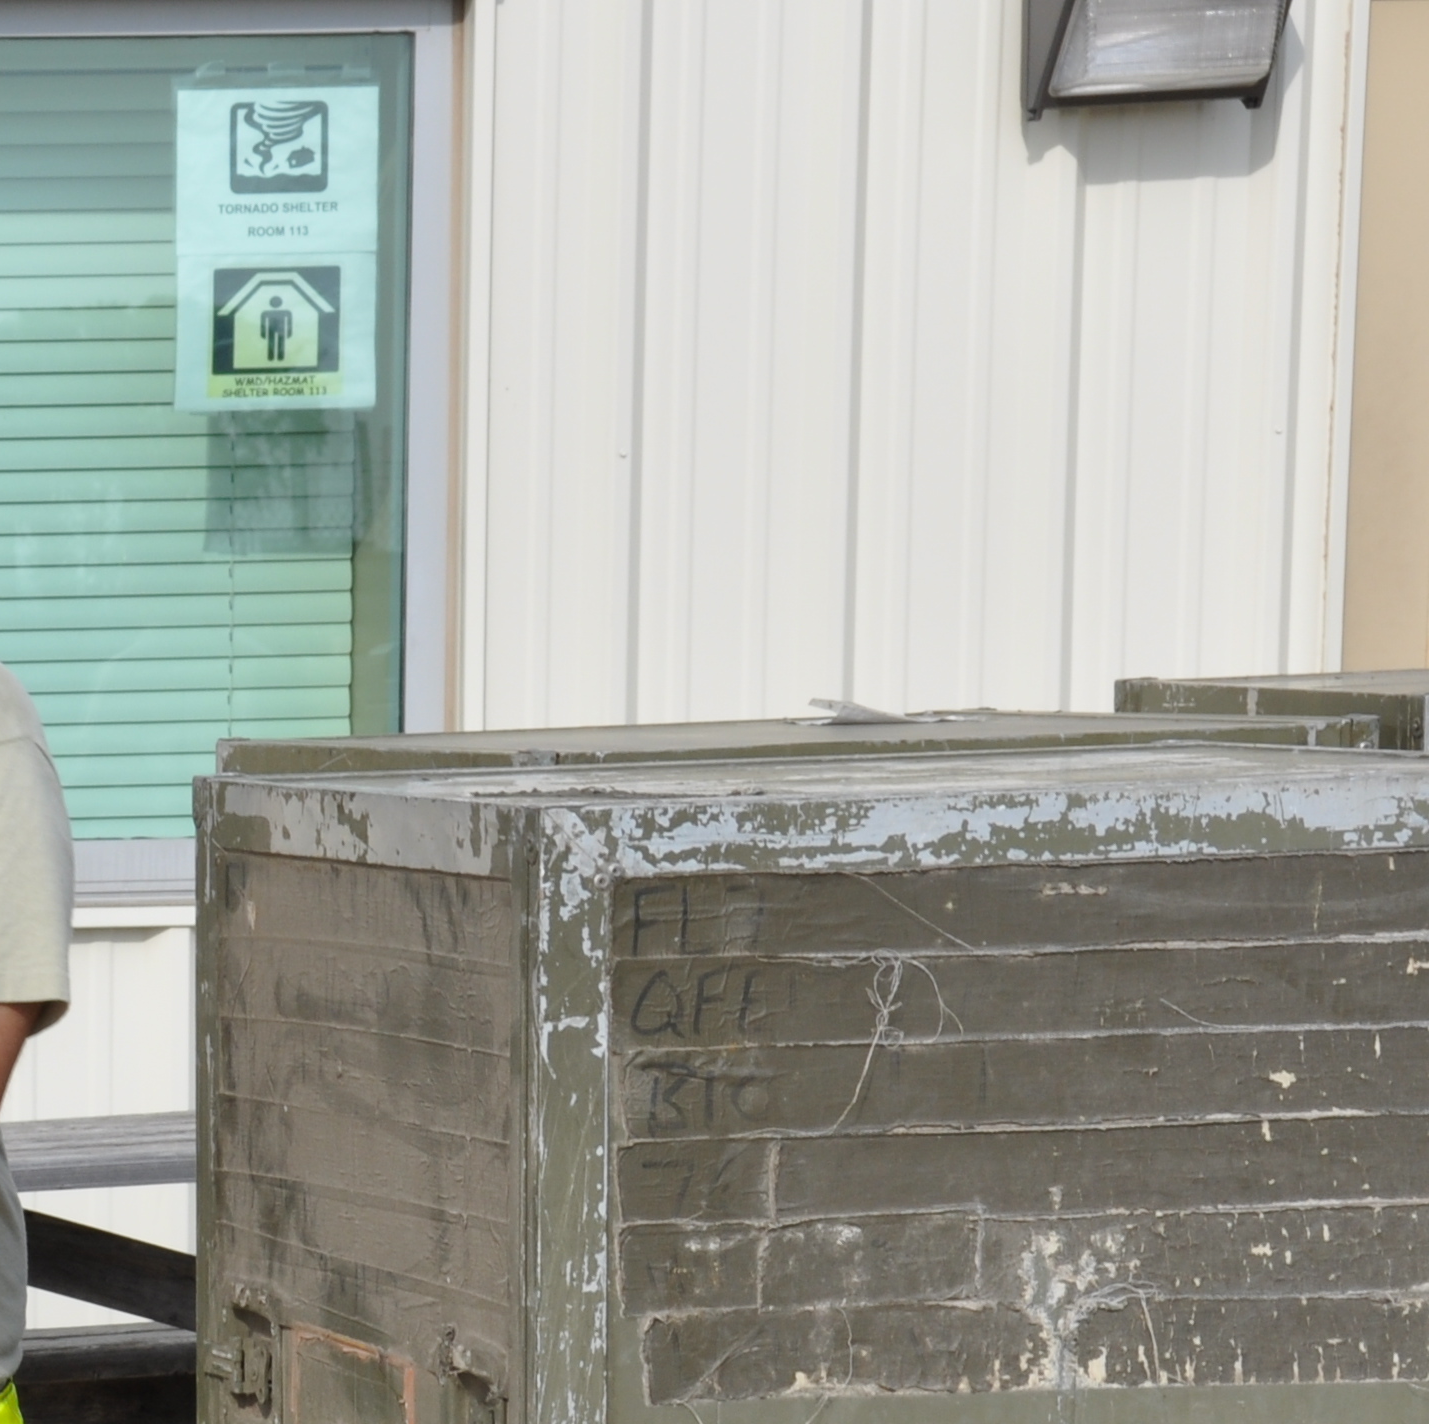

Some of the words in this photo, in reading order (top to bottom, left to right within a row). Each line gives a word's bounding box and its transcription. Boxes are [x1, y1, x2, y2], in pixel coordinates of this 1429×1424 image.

[217, 203, 279, 215] TORNADO
[282, 201, 339, 213] SHELTER
[247, 226, 286, 237] ROOM
[289, 225, 309, 236] 113
[222, 388, 269, 398] SHELTER
[272, 387, 305, 396] ROOM
